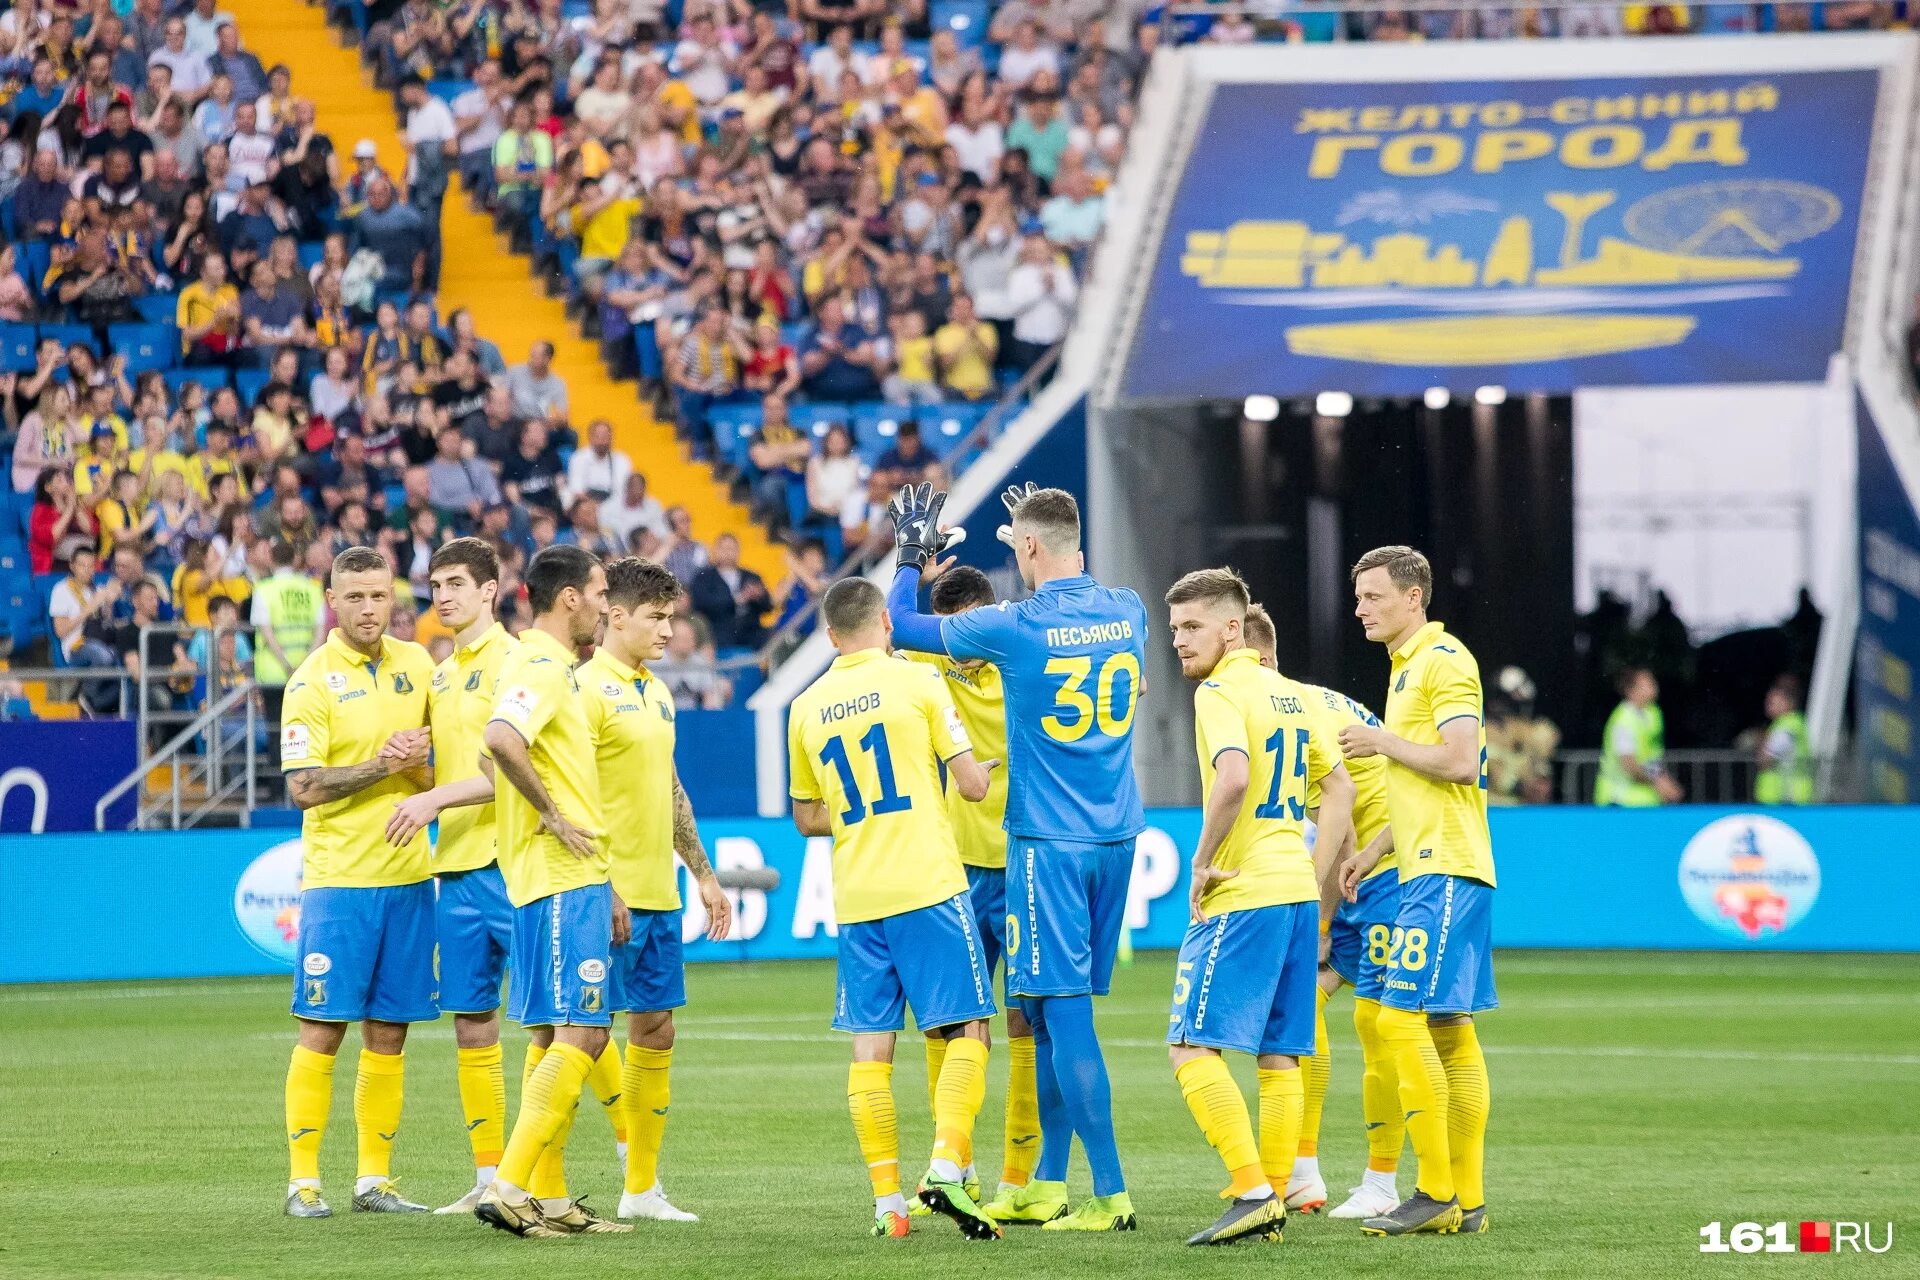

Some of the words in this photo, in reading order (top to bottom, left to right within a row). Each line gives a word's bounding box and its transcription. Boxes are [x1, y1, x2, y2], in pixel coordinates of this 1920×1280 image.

[1295, 83, 1779, 134] ЖЕЛТО-СИНИЙ
[1308, 119, 1749, 179] ГОРОД
[1047, 619, 1133, 648] ПЕСЬЯКОВ
[820, 692, 881, 725] ИОНОВ
[1040, 652, 1141, 742] 30
[1270, 695, 1305, 714] ГЛЕБО
[819, 722, 913, 826] 11
[1254, 727, 1309, 822] 15
[952, 894, 985, 1005] РОСТСЕЛЬМА
[1386, 926, 1429, 971] 28
